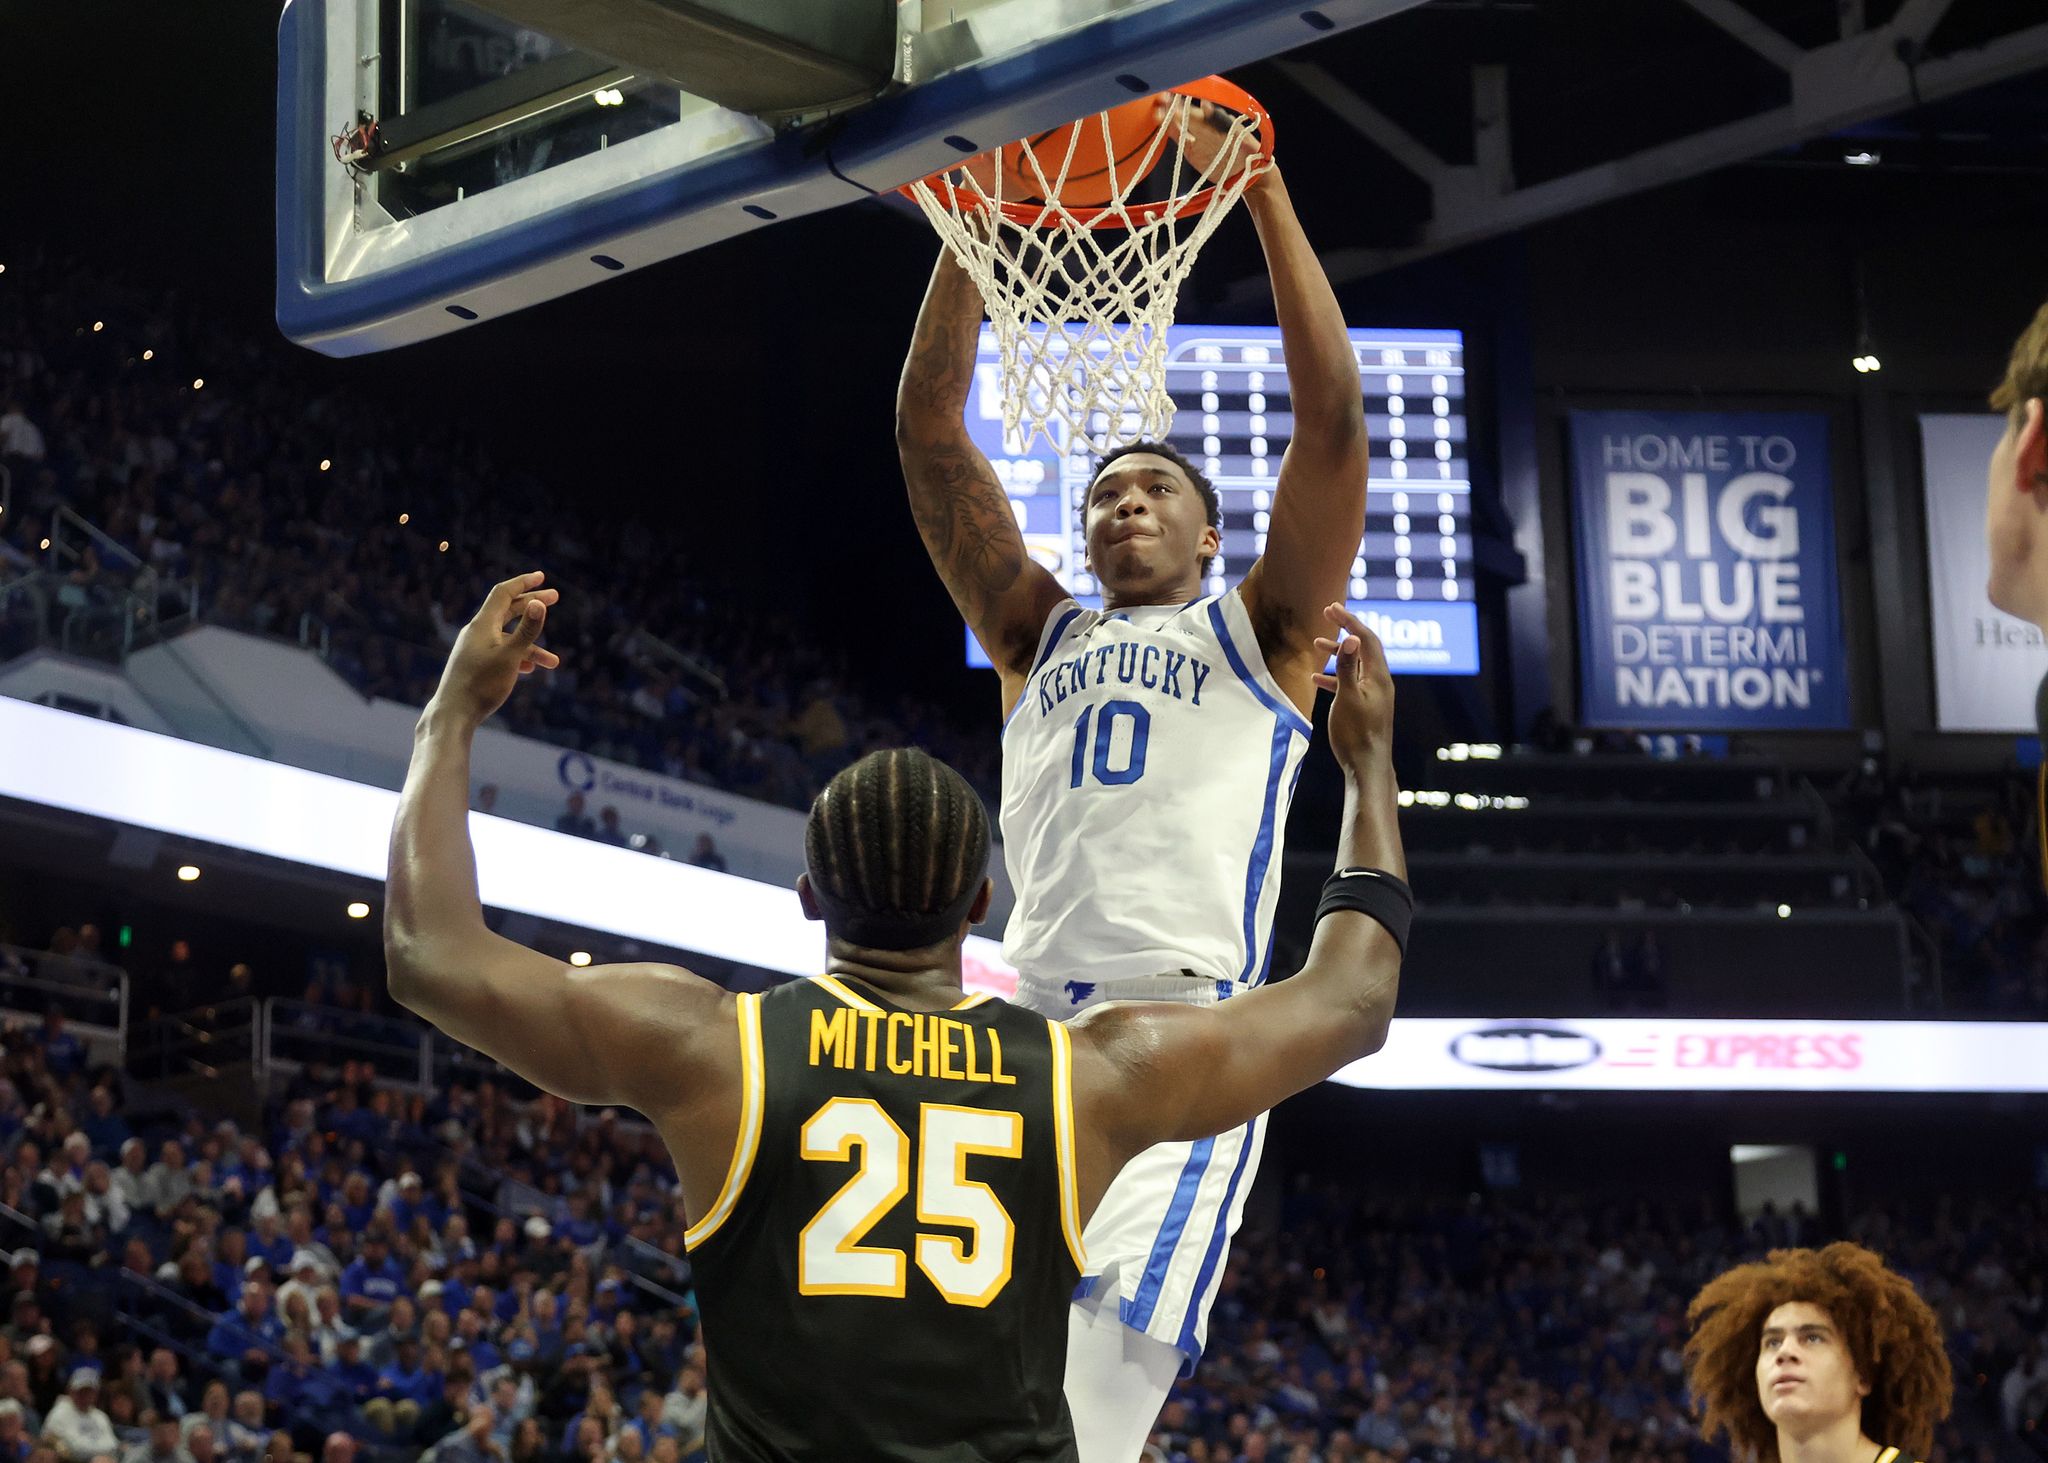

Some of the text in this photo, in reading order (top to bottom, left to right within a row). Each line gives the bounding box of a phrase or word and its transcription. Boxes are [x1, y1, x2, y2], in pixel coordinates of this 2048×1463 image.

[1603, 434, 1796, 472] HOME TO
[1605, 472, 1800, 559] BIG
[1609, 559, 1804, 625] BLUE
[1039, 642, 1210, 718] KENTUCKY
[1613, 625, 1807, 666] DETERMI
[1070, 700, 1151, 789] 10
[809, 1007, 1017, 1085] MITCHELL
[1675, 1033, 1863, 1070] EXPRESS
[799, 1096, 1023, 1308] 25
